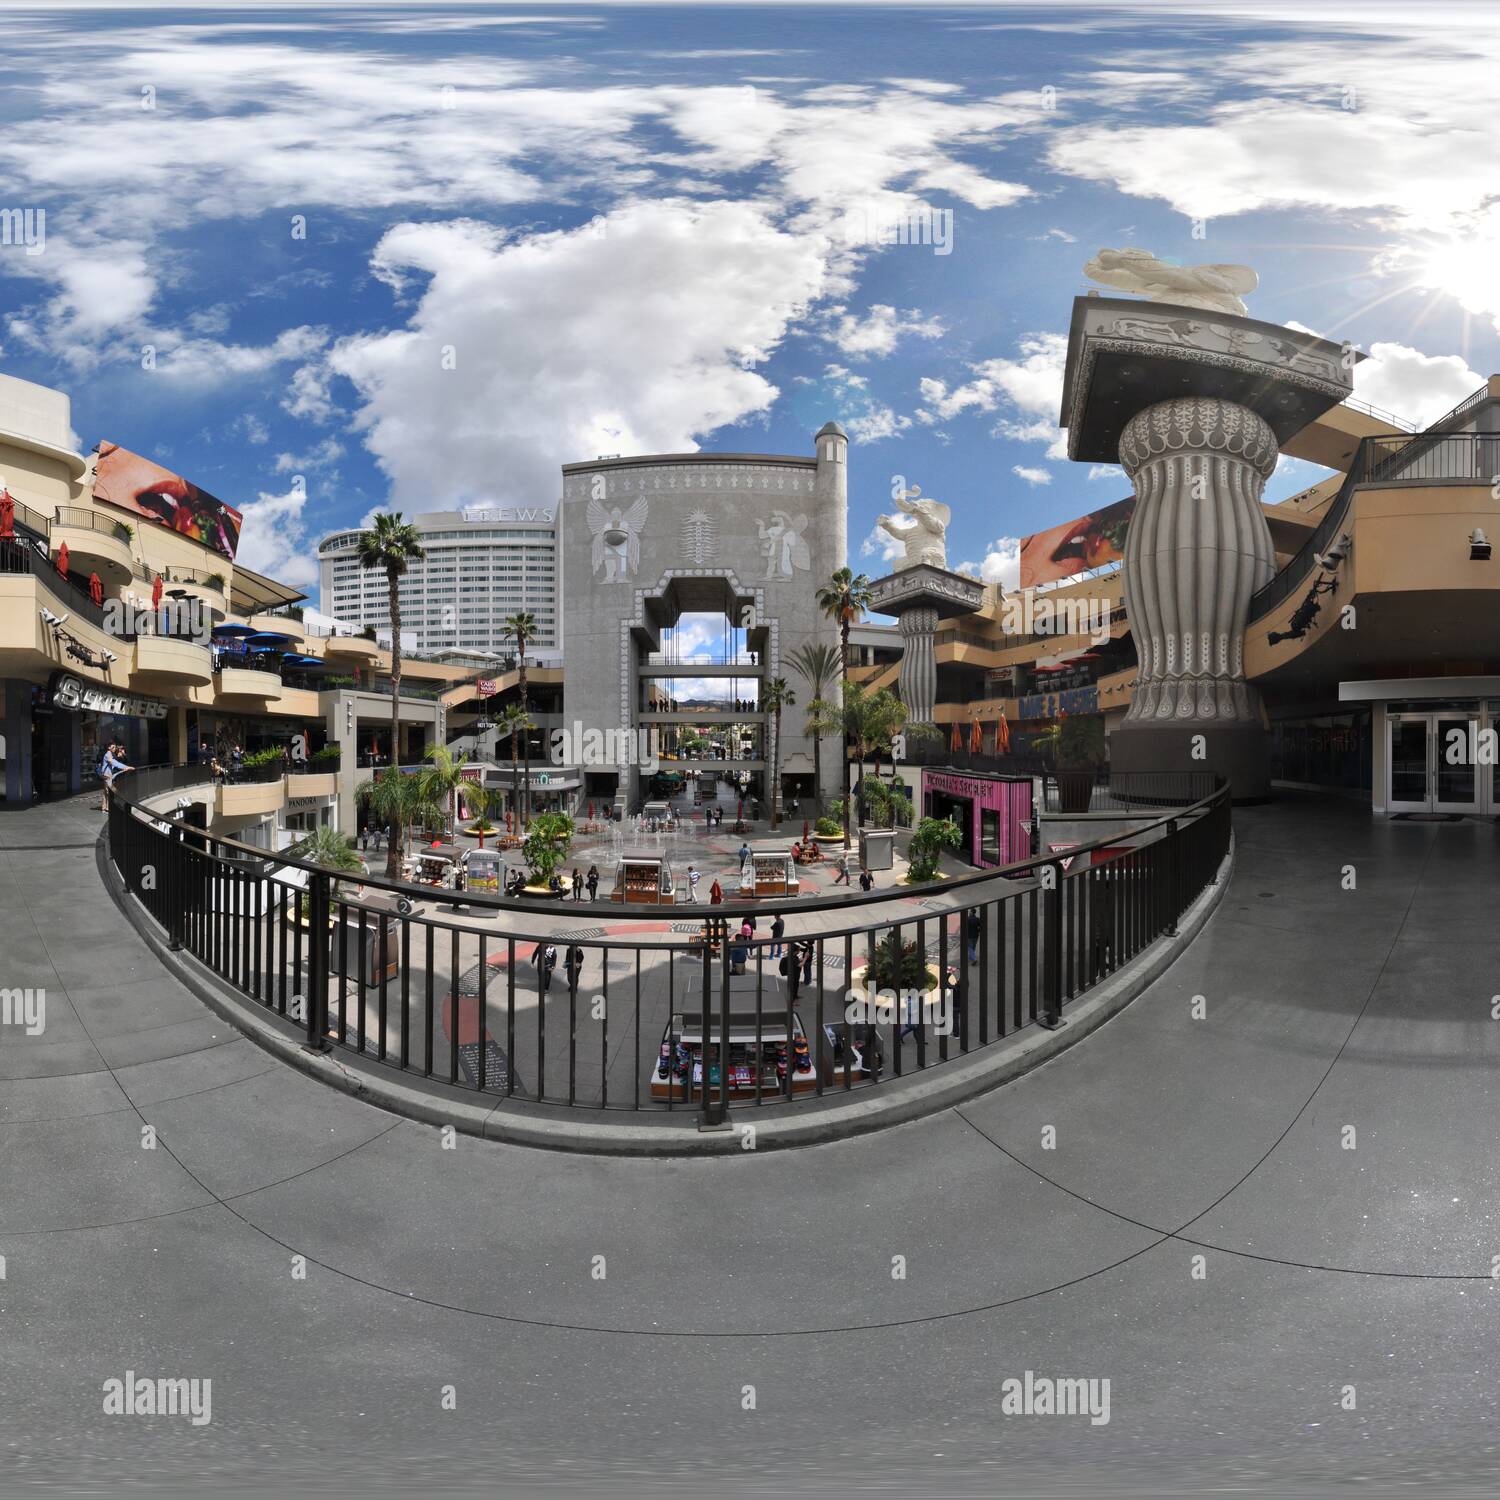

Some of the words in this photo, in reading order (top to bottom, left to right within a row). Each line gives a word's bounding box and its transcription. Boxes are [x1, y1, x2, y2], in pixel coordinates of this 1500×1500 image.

[81, 688, 169, 719] SKECHERS
[288, 796, 317, 809] PANDORA
[400, 902, 408, 913] 2
